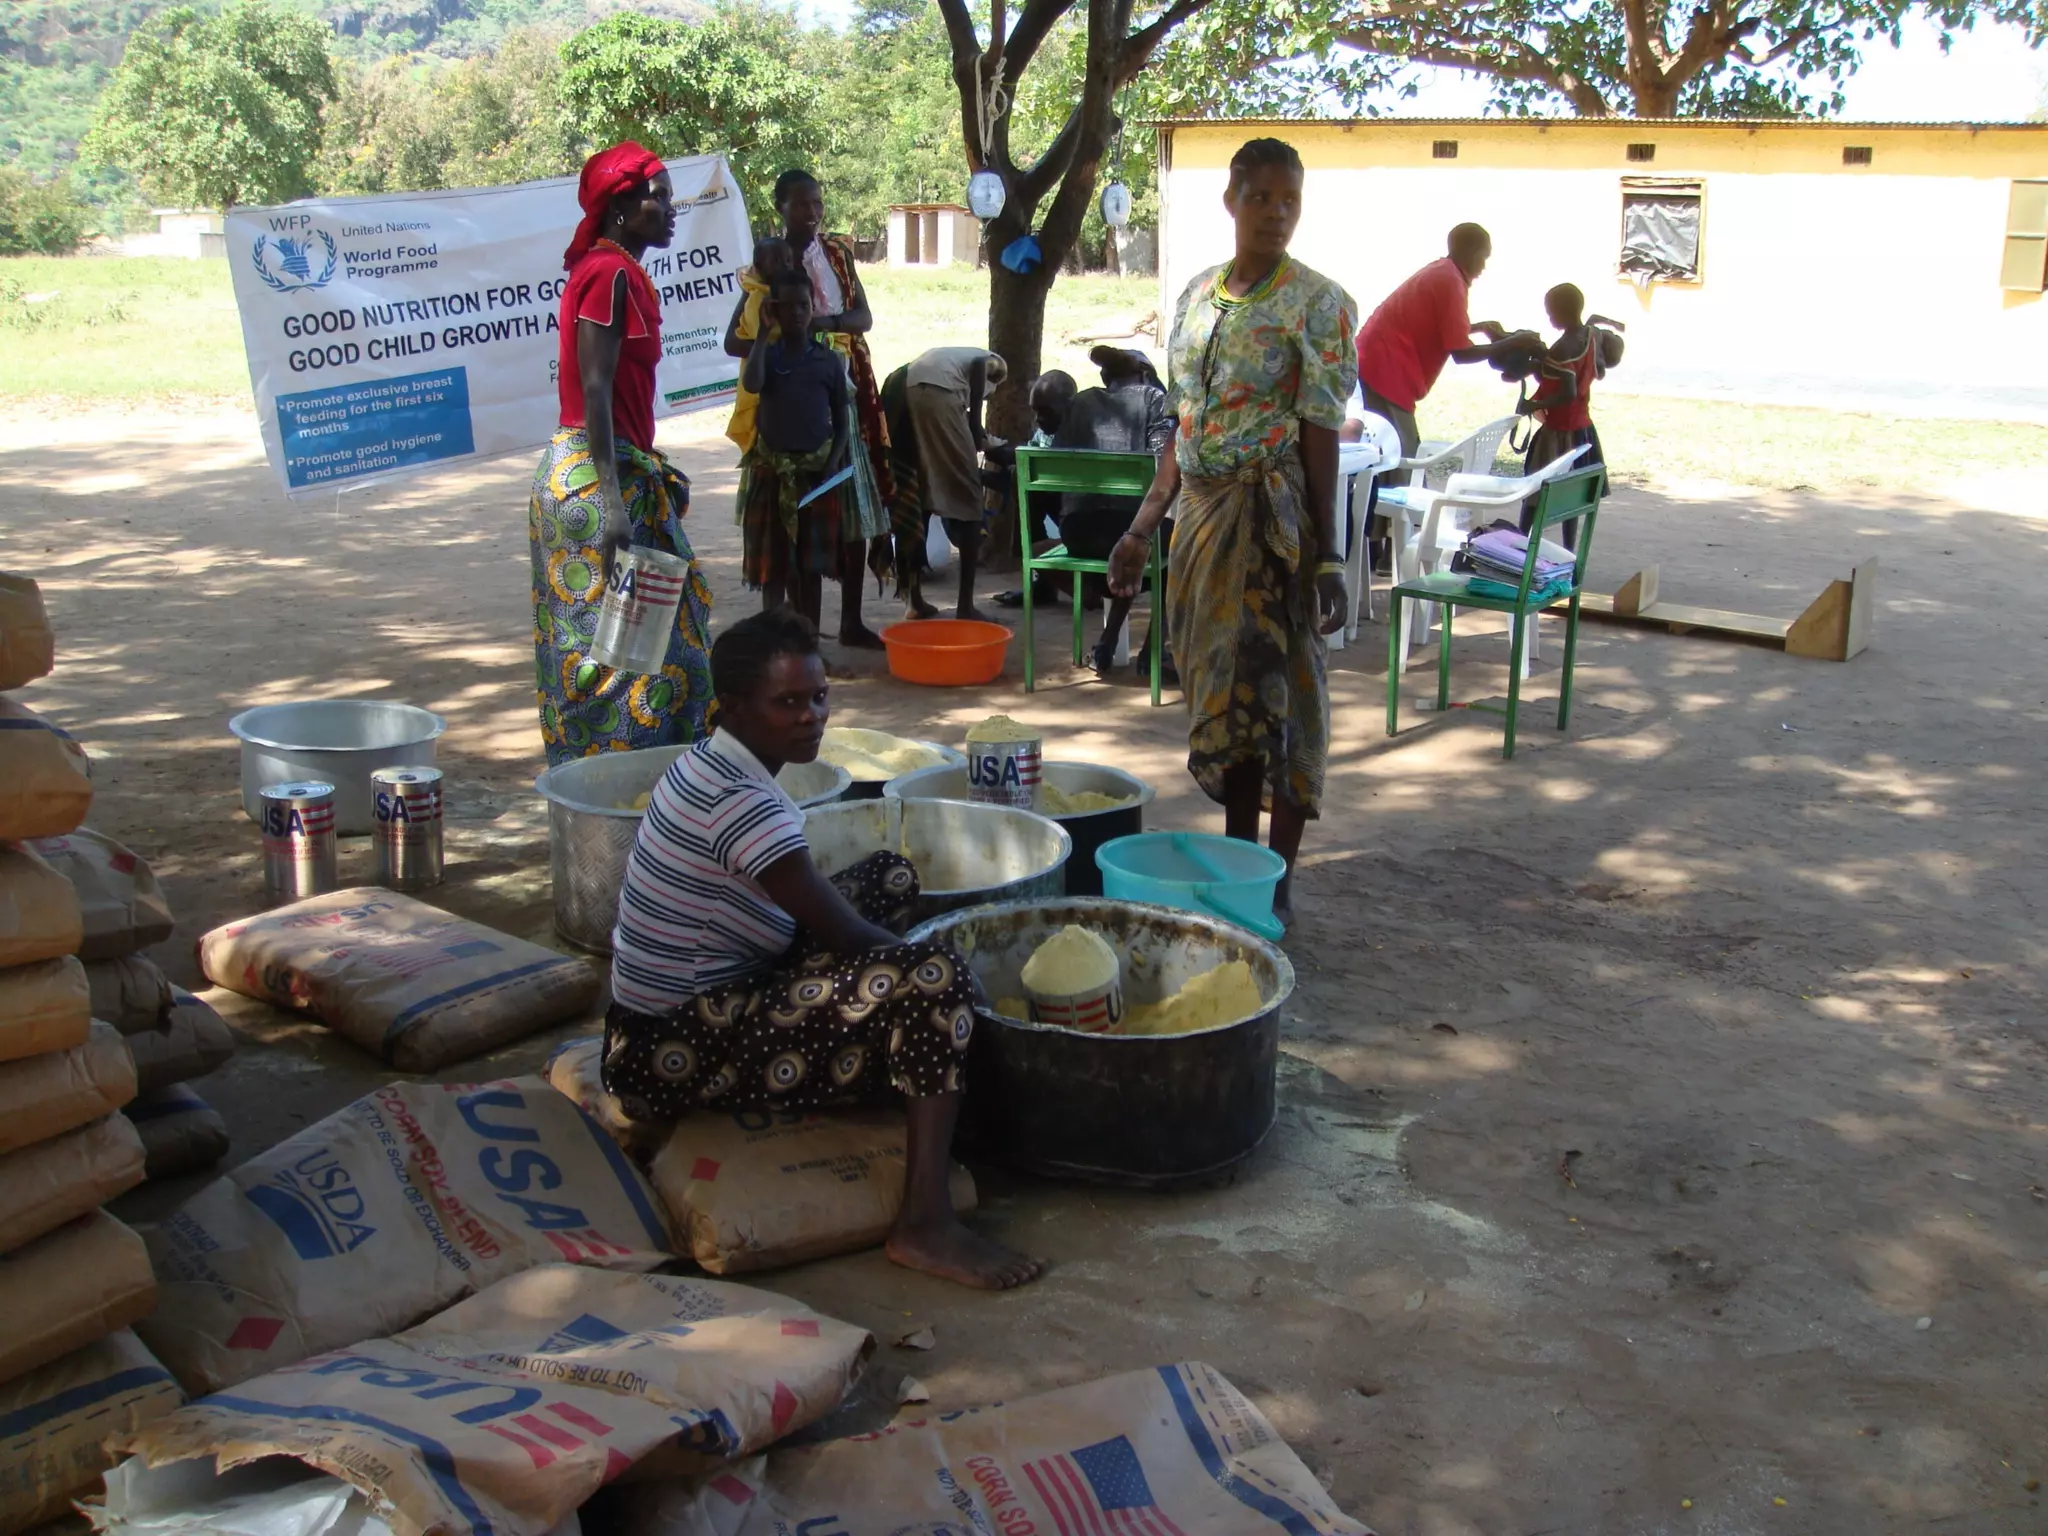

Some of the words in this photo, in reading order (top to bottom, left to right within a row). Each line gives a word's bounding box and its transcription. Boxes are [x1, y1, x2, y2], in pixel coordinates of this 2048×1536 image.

[269, 214, 311, 232] WFP
[342, 224, 383, 238] United
[386, 221, 431, 232] Nations
[343, 248, 392, 264] World
[397, 243, 438, 259] Food
[347, 259, 438, 280] Programme
[283, 309, 356, 338] GOOD
[362, 291, 481, 328] NUTRITION
[487, 284, 533, 310] FOR
[538, 278, 567, 301] GO
[677, 245, 723, 272] FOR
[289, 343, 360, 372] GOOD
[367, 331, 436, 360] CHILD
[443, 315, 540, 348] GROWTH
[666, 339, 718, 357] Karamoja
[286, 395, 344, 412] Promote
[347, 384, 408, 401] exclusive
[412, 376, 453, 392] breast
[296, 408, 347, 425] feeding
[350, 404, 368, 416] for
[371, 400, 392, 411] the
[395, 395, 422, 408] first
[425, 392, 444, 402] six
[299, 422, 350, 439] months
[296, 449, 352, 467] Promote
[356, 441, 388, 459] good
[392, 432, 442, 450] hygiene
[306, 466, 332, 480] and
[335, 454, 398, 475] sanitation
[609, 562, 636, 599] SA
[969, 753, 1021, 787] USA
[260, 804, 307, 838] USA
[367, 1113, 385, 1130] TO
[376, 1130, 397, 1146] BE
[375, 1086, 426, 1145] CORN
[409, 1146, 451, 1191] SOY
[441, 1196, 501, 1259] BLEND
[386, 1148, 411, 1184] SOLD
[455, 1091, 590, 1230] USA
[294, 1148, 378, 1252] USDA
[403, 1186, 424, 1204] OR
[415, 1204, 472, 1272] EXCHANGED
[530, 1358, 569, 1379] SOLD
[569, 1363, 587, 1382] BE
[590, 1367, 612, 1382] TO
[612, 1371, 648, 1394] NOT
[965, 1456, 1018, 1510] CORN
[997, 1507, 1038, 1536] SO
